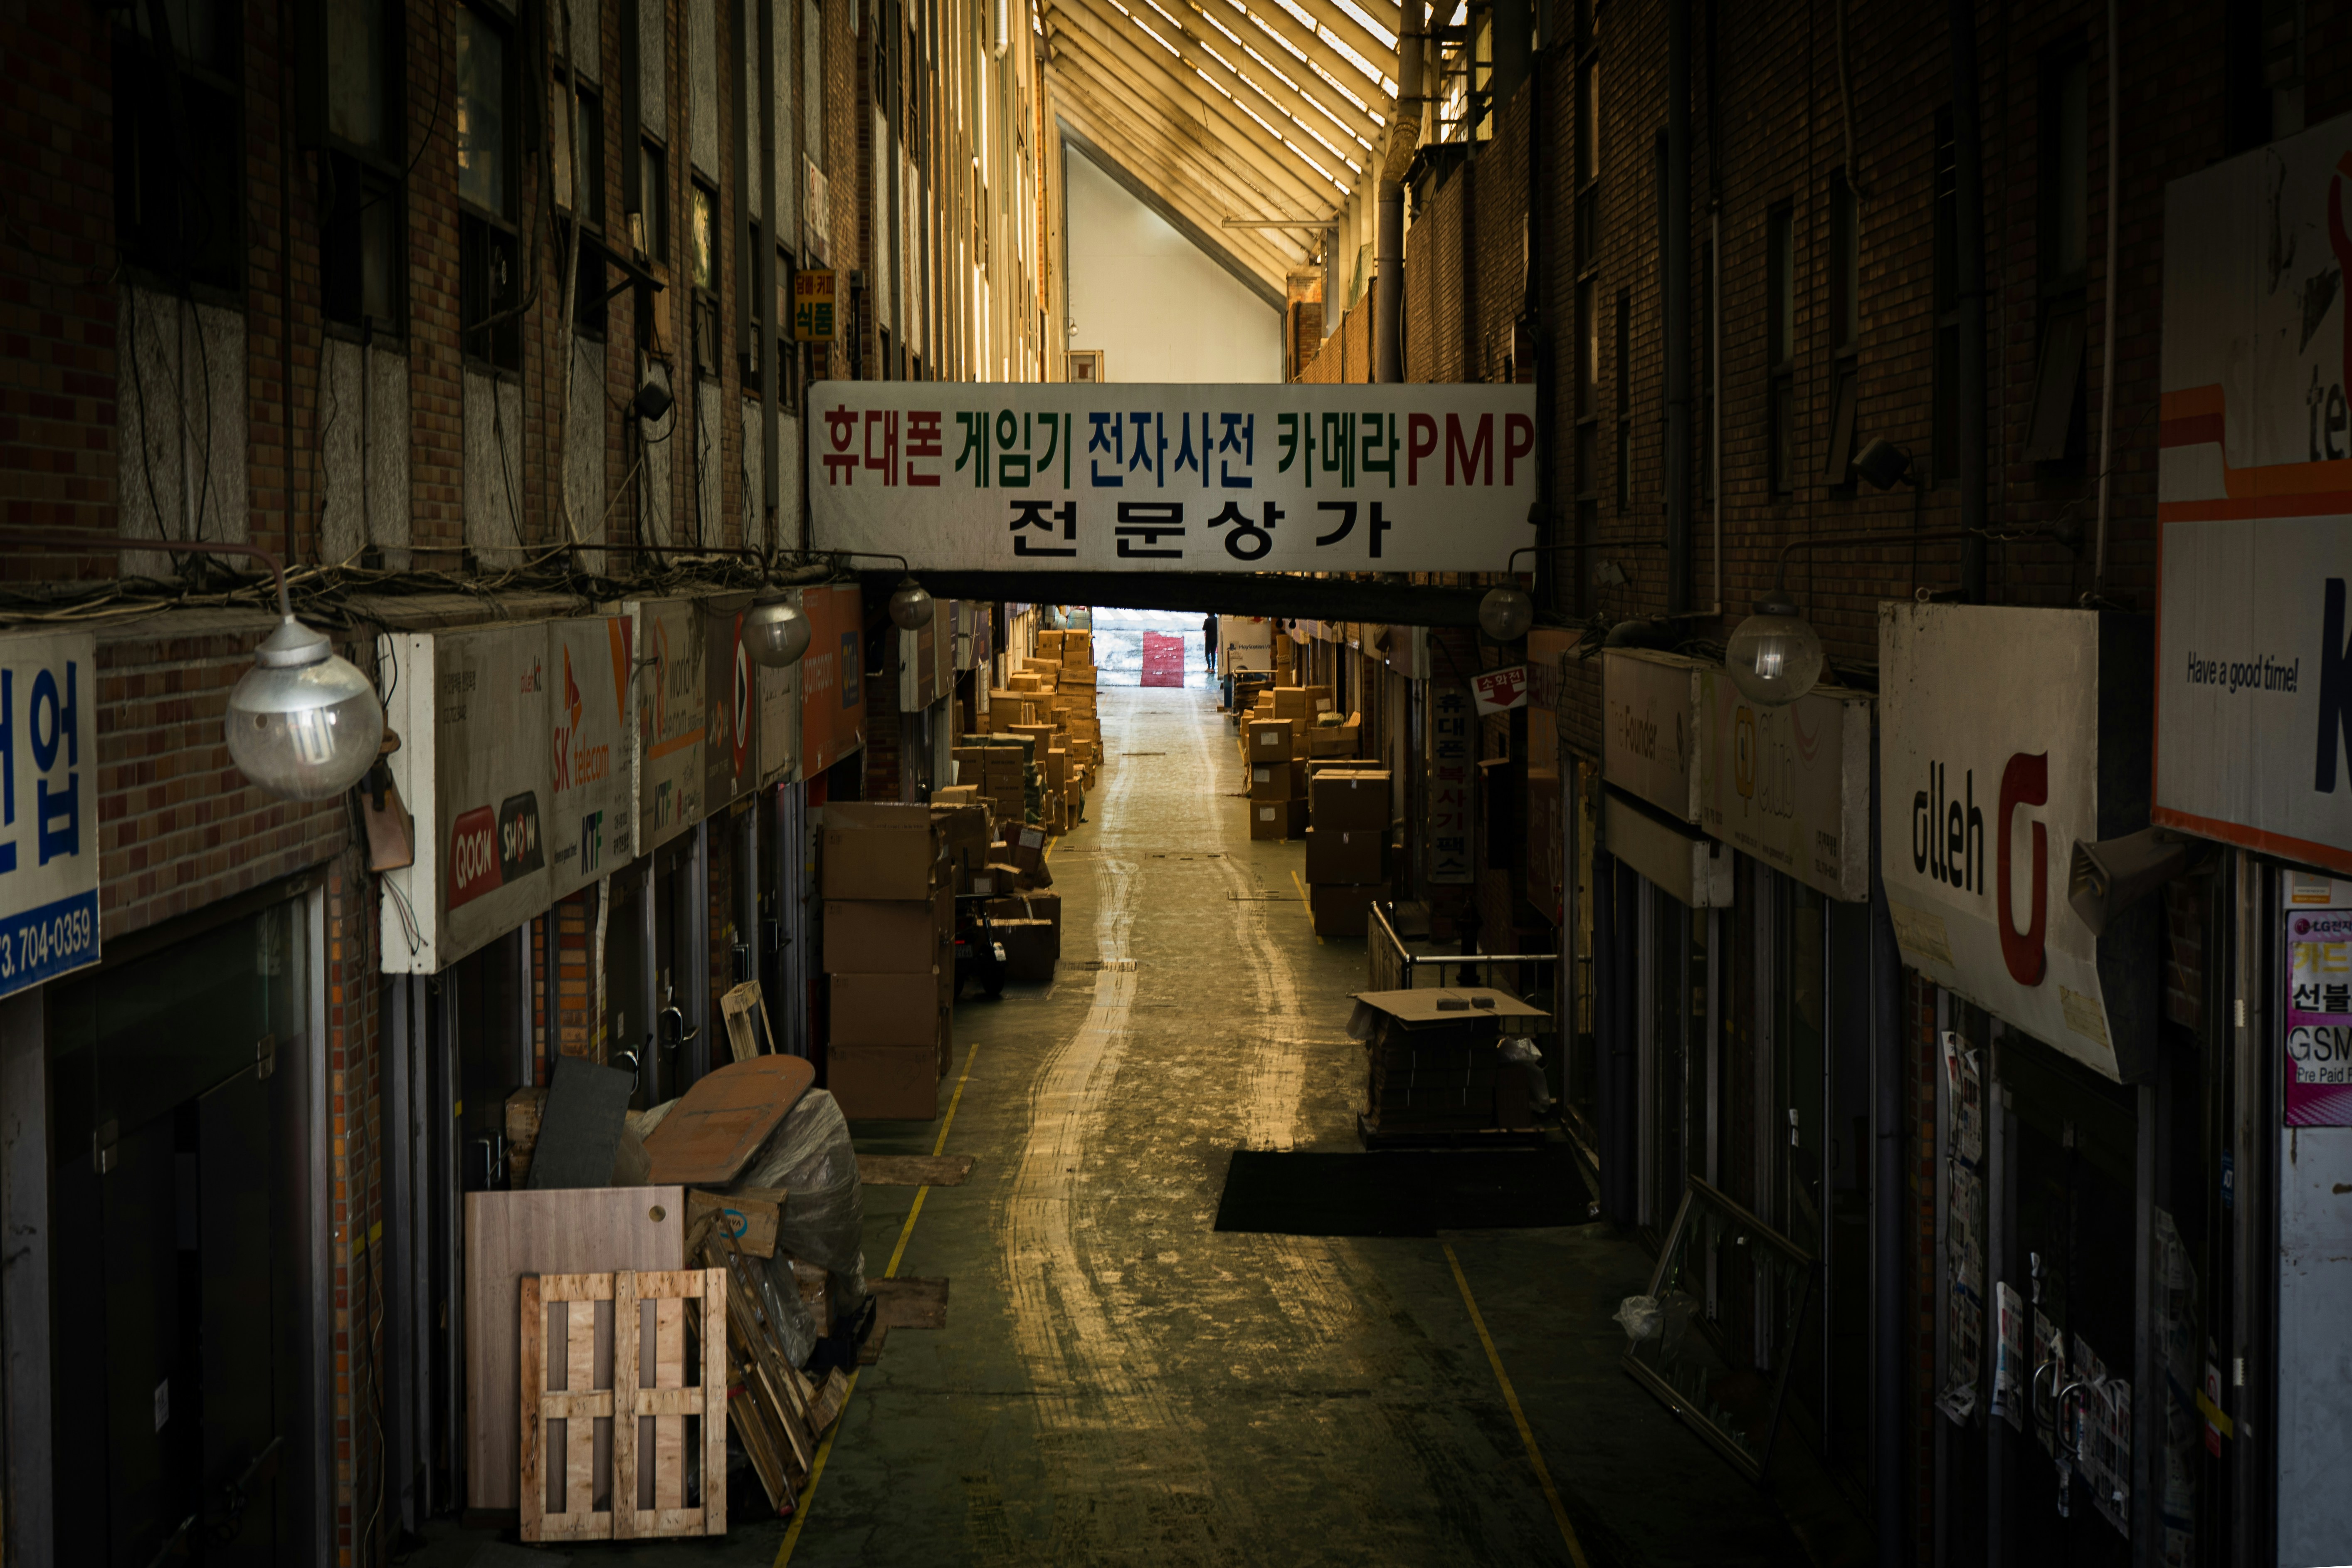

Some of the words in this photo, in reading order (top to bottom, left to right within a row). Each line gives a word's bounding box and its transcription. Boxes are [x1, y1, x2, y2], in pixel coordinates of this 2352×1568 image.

[797, 303, 833, 336] 식품
[823, 403, 942, 487] 휴대폰
[955, 409, 1071, 489] 게임기
[1088, 412, 1254, 488] 전자사전
[1278, 412, 1400, 488] 카메라
[1408, 413, 1534, 486] PMP
[669, 641, 690, 699] world
[1482, 670, 1521, 690] 소화전
[2187, 651, 2216, 684] Have
[2220, 662, 2226, 685] a
[2230, 654, 2262, 694] good
[2264, 655, 2299, 693] time!
[553, 726, 570, 794] SK
[574, 732, 609, 787] telecom
[1625, 705, 1657, 761] Founder
[654, 778, 672, 832] KTF
[1913, 760, 1984, 896] olleh
[503, 812, 536, 863] SHOW
[582, 809, 603, 876] KTF
[19, 906, 91, 973] 704-0359
[2294, 943, 2350, 973] 카드
[2298, 1067, 2315, 1082] Pre
[2320, 1067, 2344, 1082] Paid
